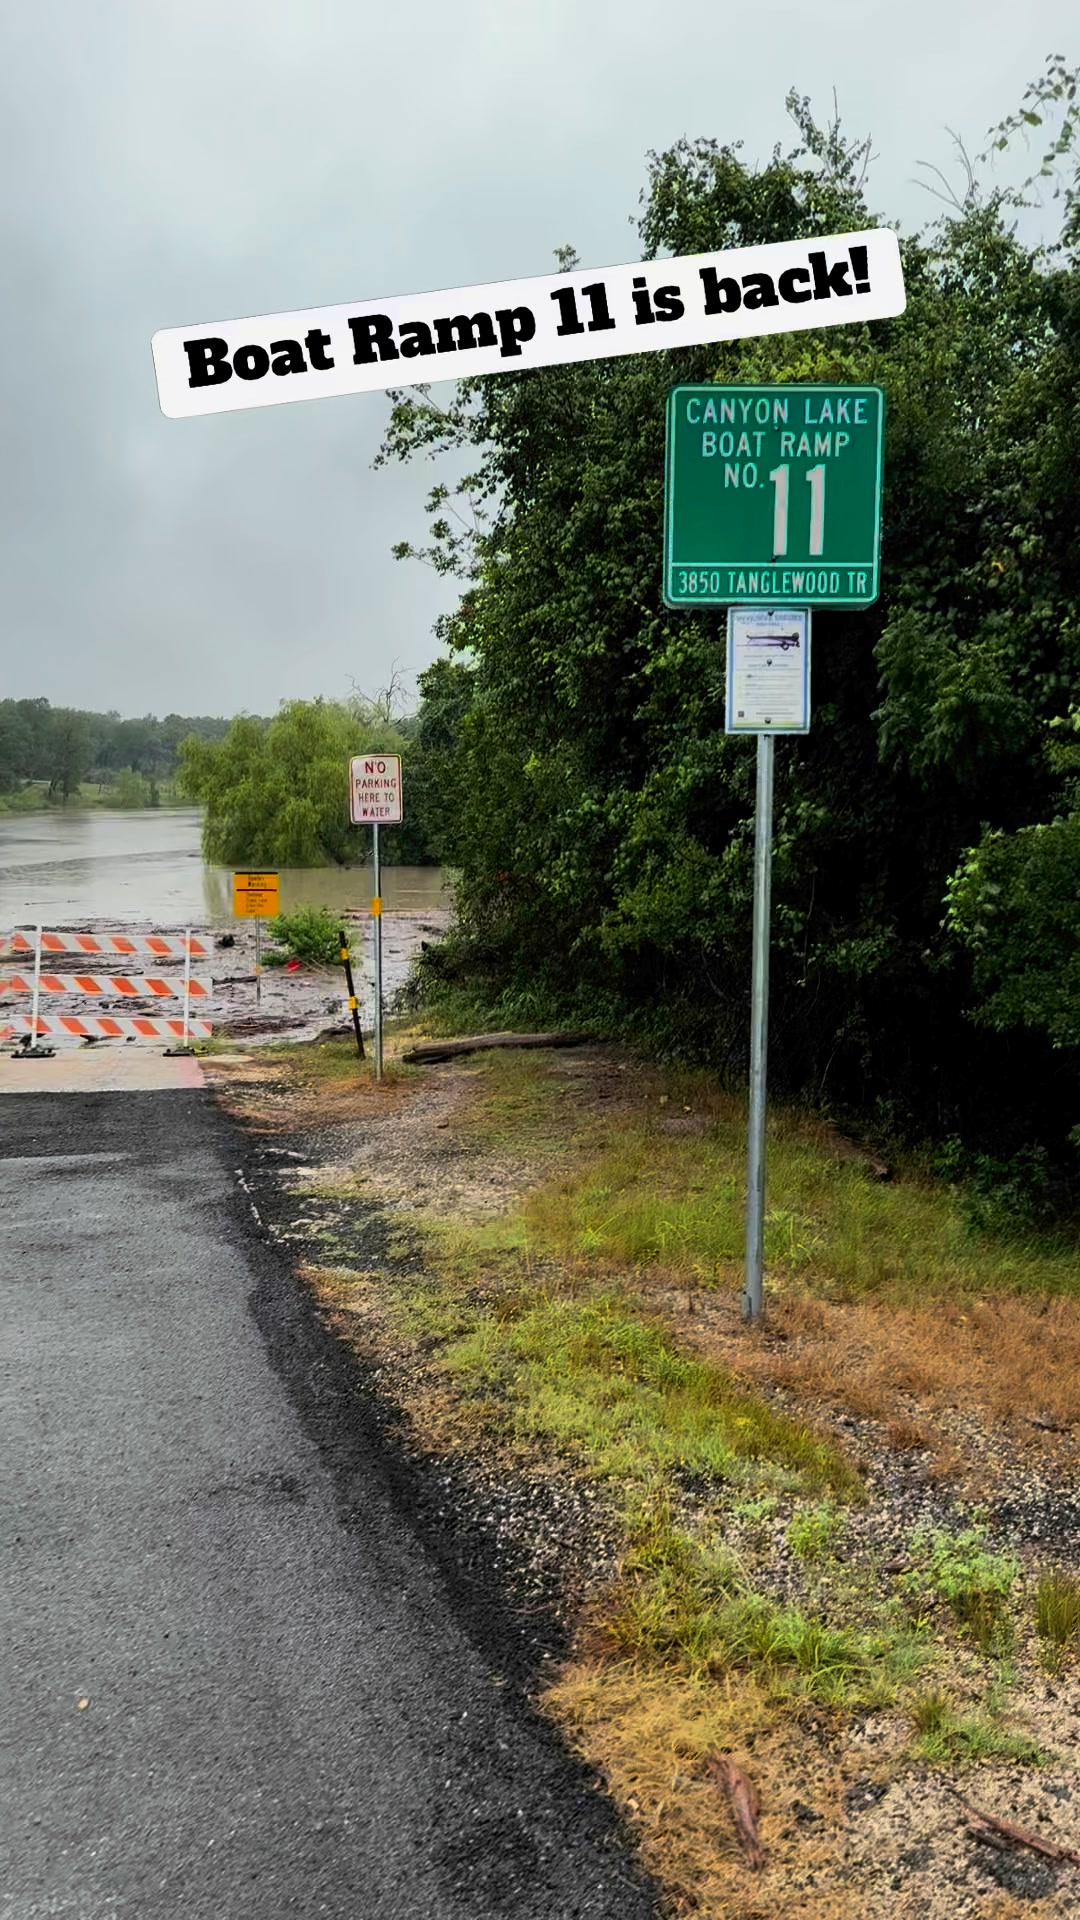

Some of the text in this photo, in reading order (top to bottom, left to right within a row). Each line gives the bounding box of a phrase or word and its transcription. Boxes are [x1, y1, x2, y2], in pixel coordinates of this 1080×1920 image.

[686, 398, 868, 424] CANYON LAKE
[702, 431, 850, 457] BOAT RAMP
[724, 462, 826, 556] NO. 11
[678, 571, 868, 594] 3850 TANGLEWOOD TR
[364, 761, 386, 774] NO
[355, 778, 397, 789] PARKING
[358, 792, 395, 803] HERE TO
[362, 807, 390, 817] WATER
